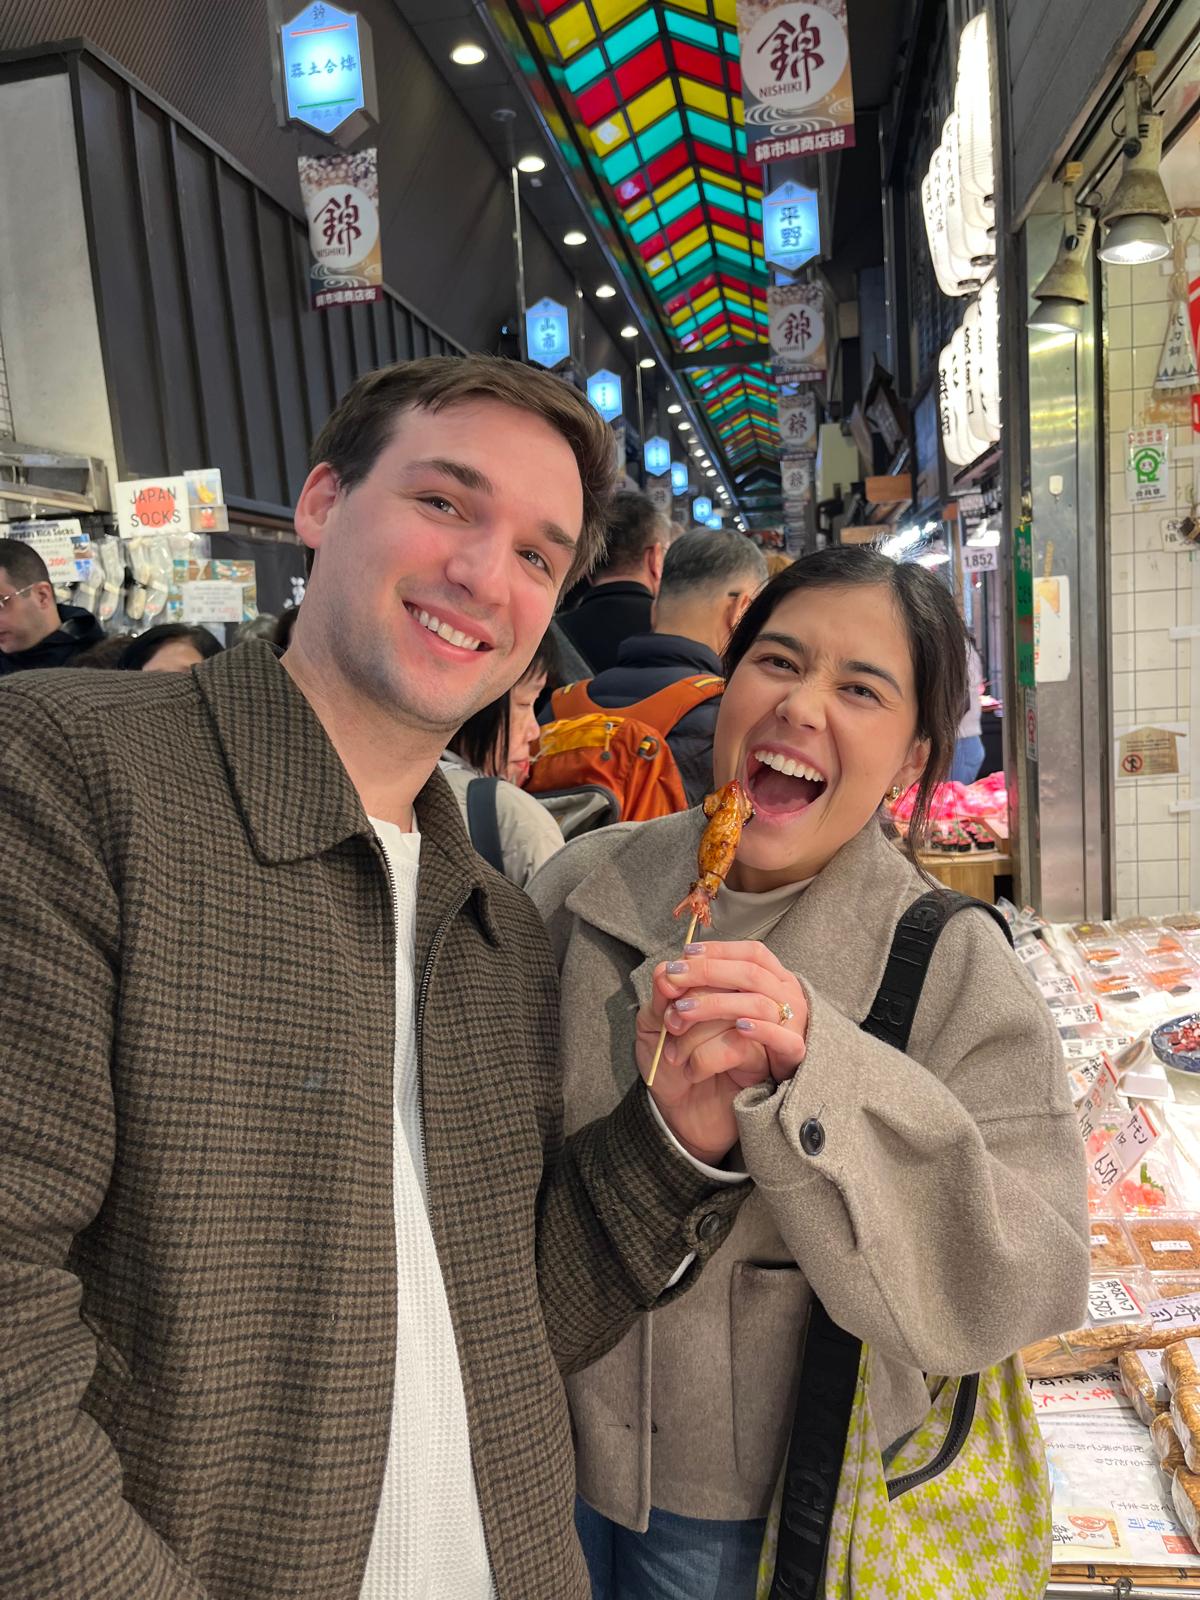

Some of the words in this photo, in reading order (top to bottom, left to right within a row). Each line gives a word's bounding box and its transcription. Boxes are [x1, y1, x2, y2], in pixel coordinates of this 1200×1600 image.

[757, 13, 824, 94] 錦
[759, 81, 802, 98] NISHIKI
[754, 129, 846, 162] 錦市場商店街
[313, 193, 362, 257] 錦
[780, 206, 802, 248] 平野
[777, 309, 812, 353] 錦
[130, 486, 177, 505] JAPAN
[130, 509, 182, 528] SOCKS
